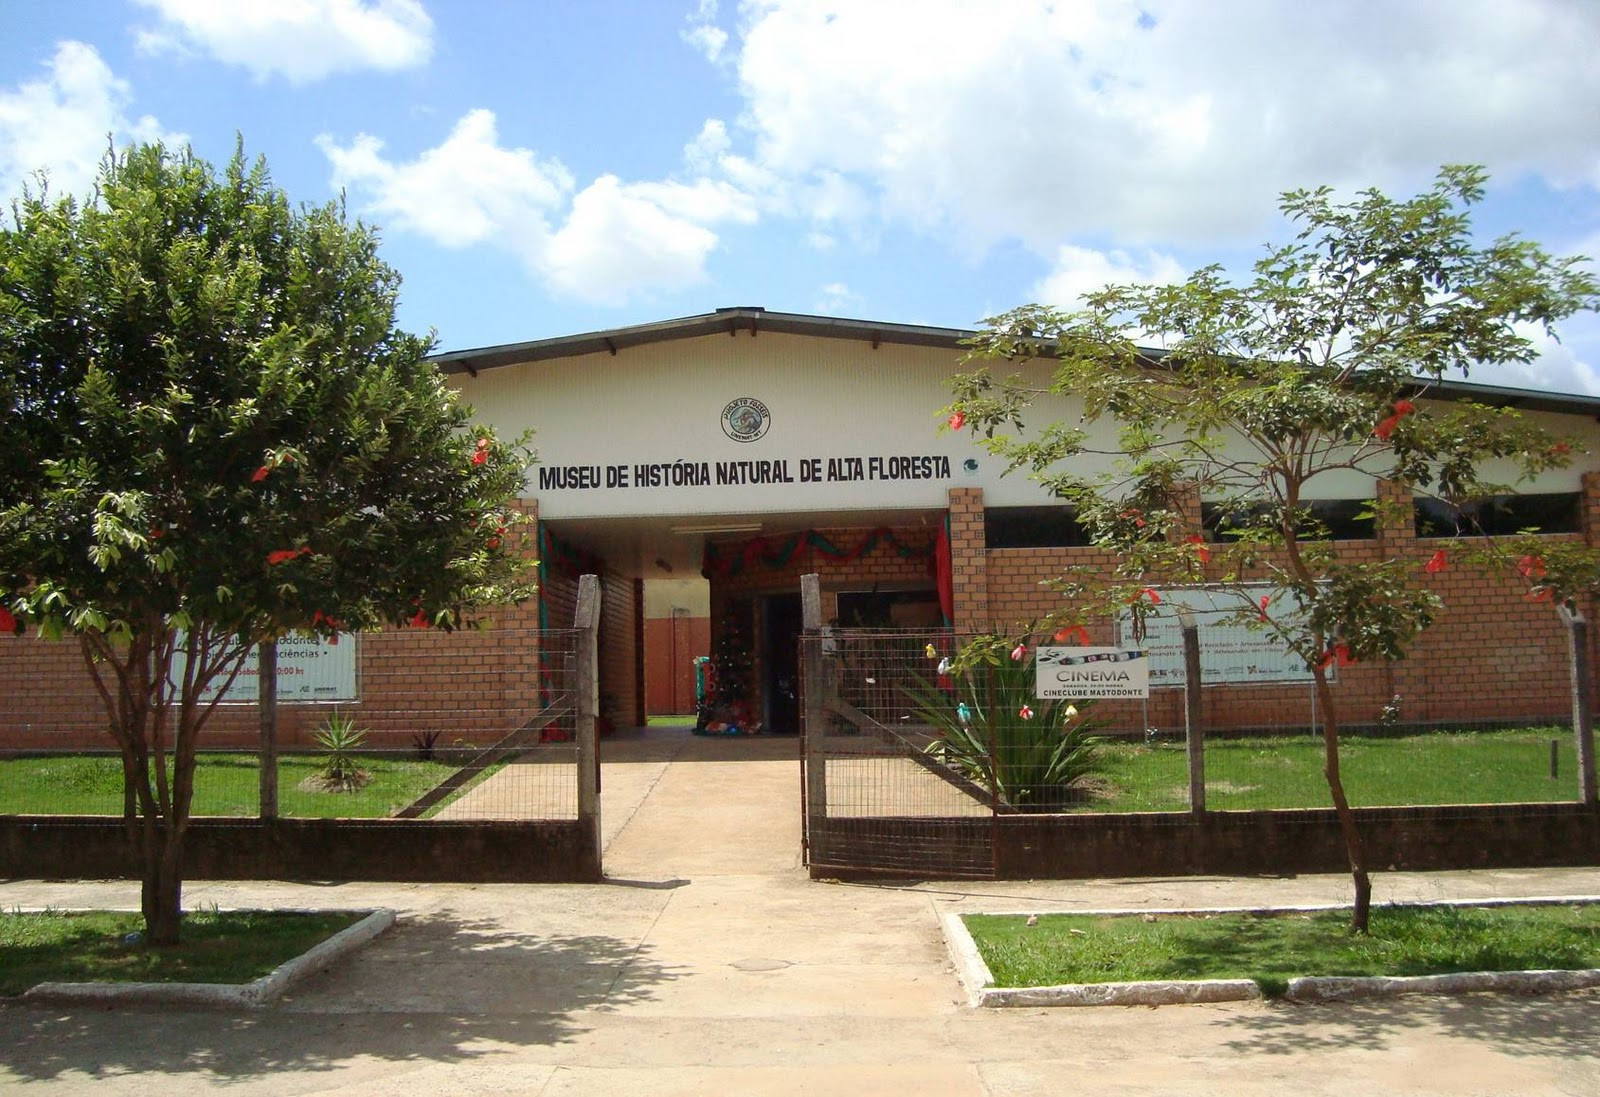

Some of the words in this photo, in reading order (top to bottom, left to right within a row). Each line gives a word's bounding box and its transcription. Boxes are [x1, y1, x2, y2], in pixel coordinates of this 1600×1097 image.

[540, 466, 601, 491] MUSEU
[606, 466, 628, 488] DE
[634, 458, 711, 488] HISTÓRIA
[716, 460, 794, 485] NATURAL
[800, 459, 822, 482] DE
[827, 457, 865, 482] ALTA
[868, 456, 951, 481] FLORESTA
[1056, 670, 1130, 683] CINEMA
[1043, 689, 1088, 698] CINECLUBE
[1089, 688, 1143, 697] MASTODONTE
